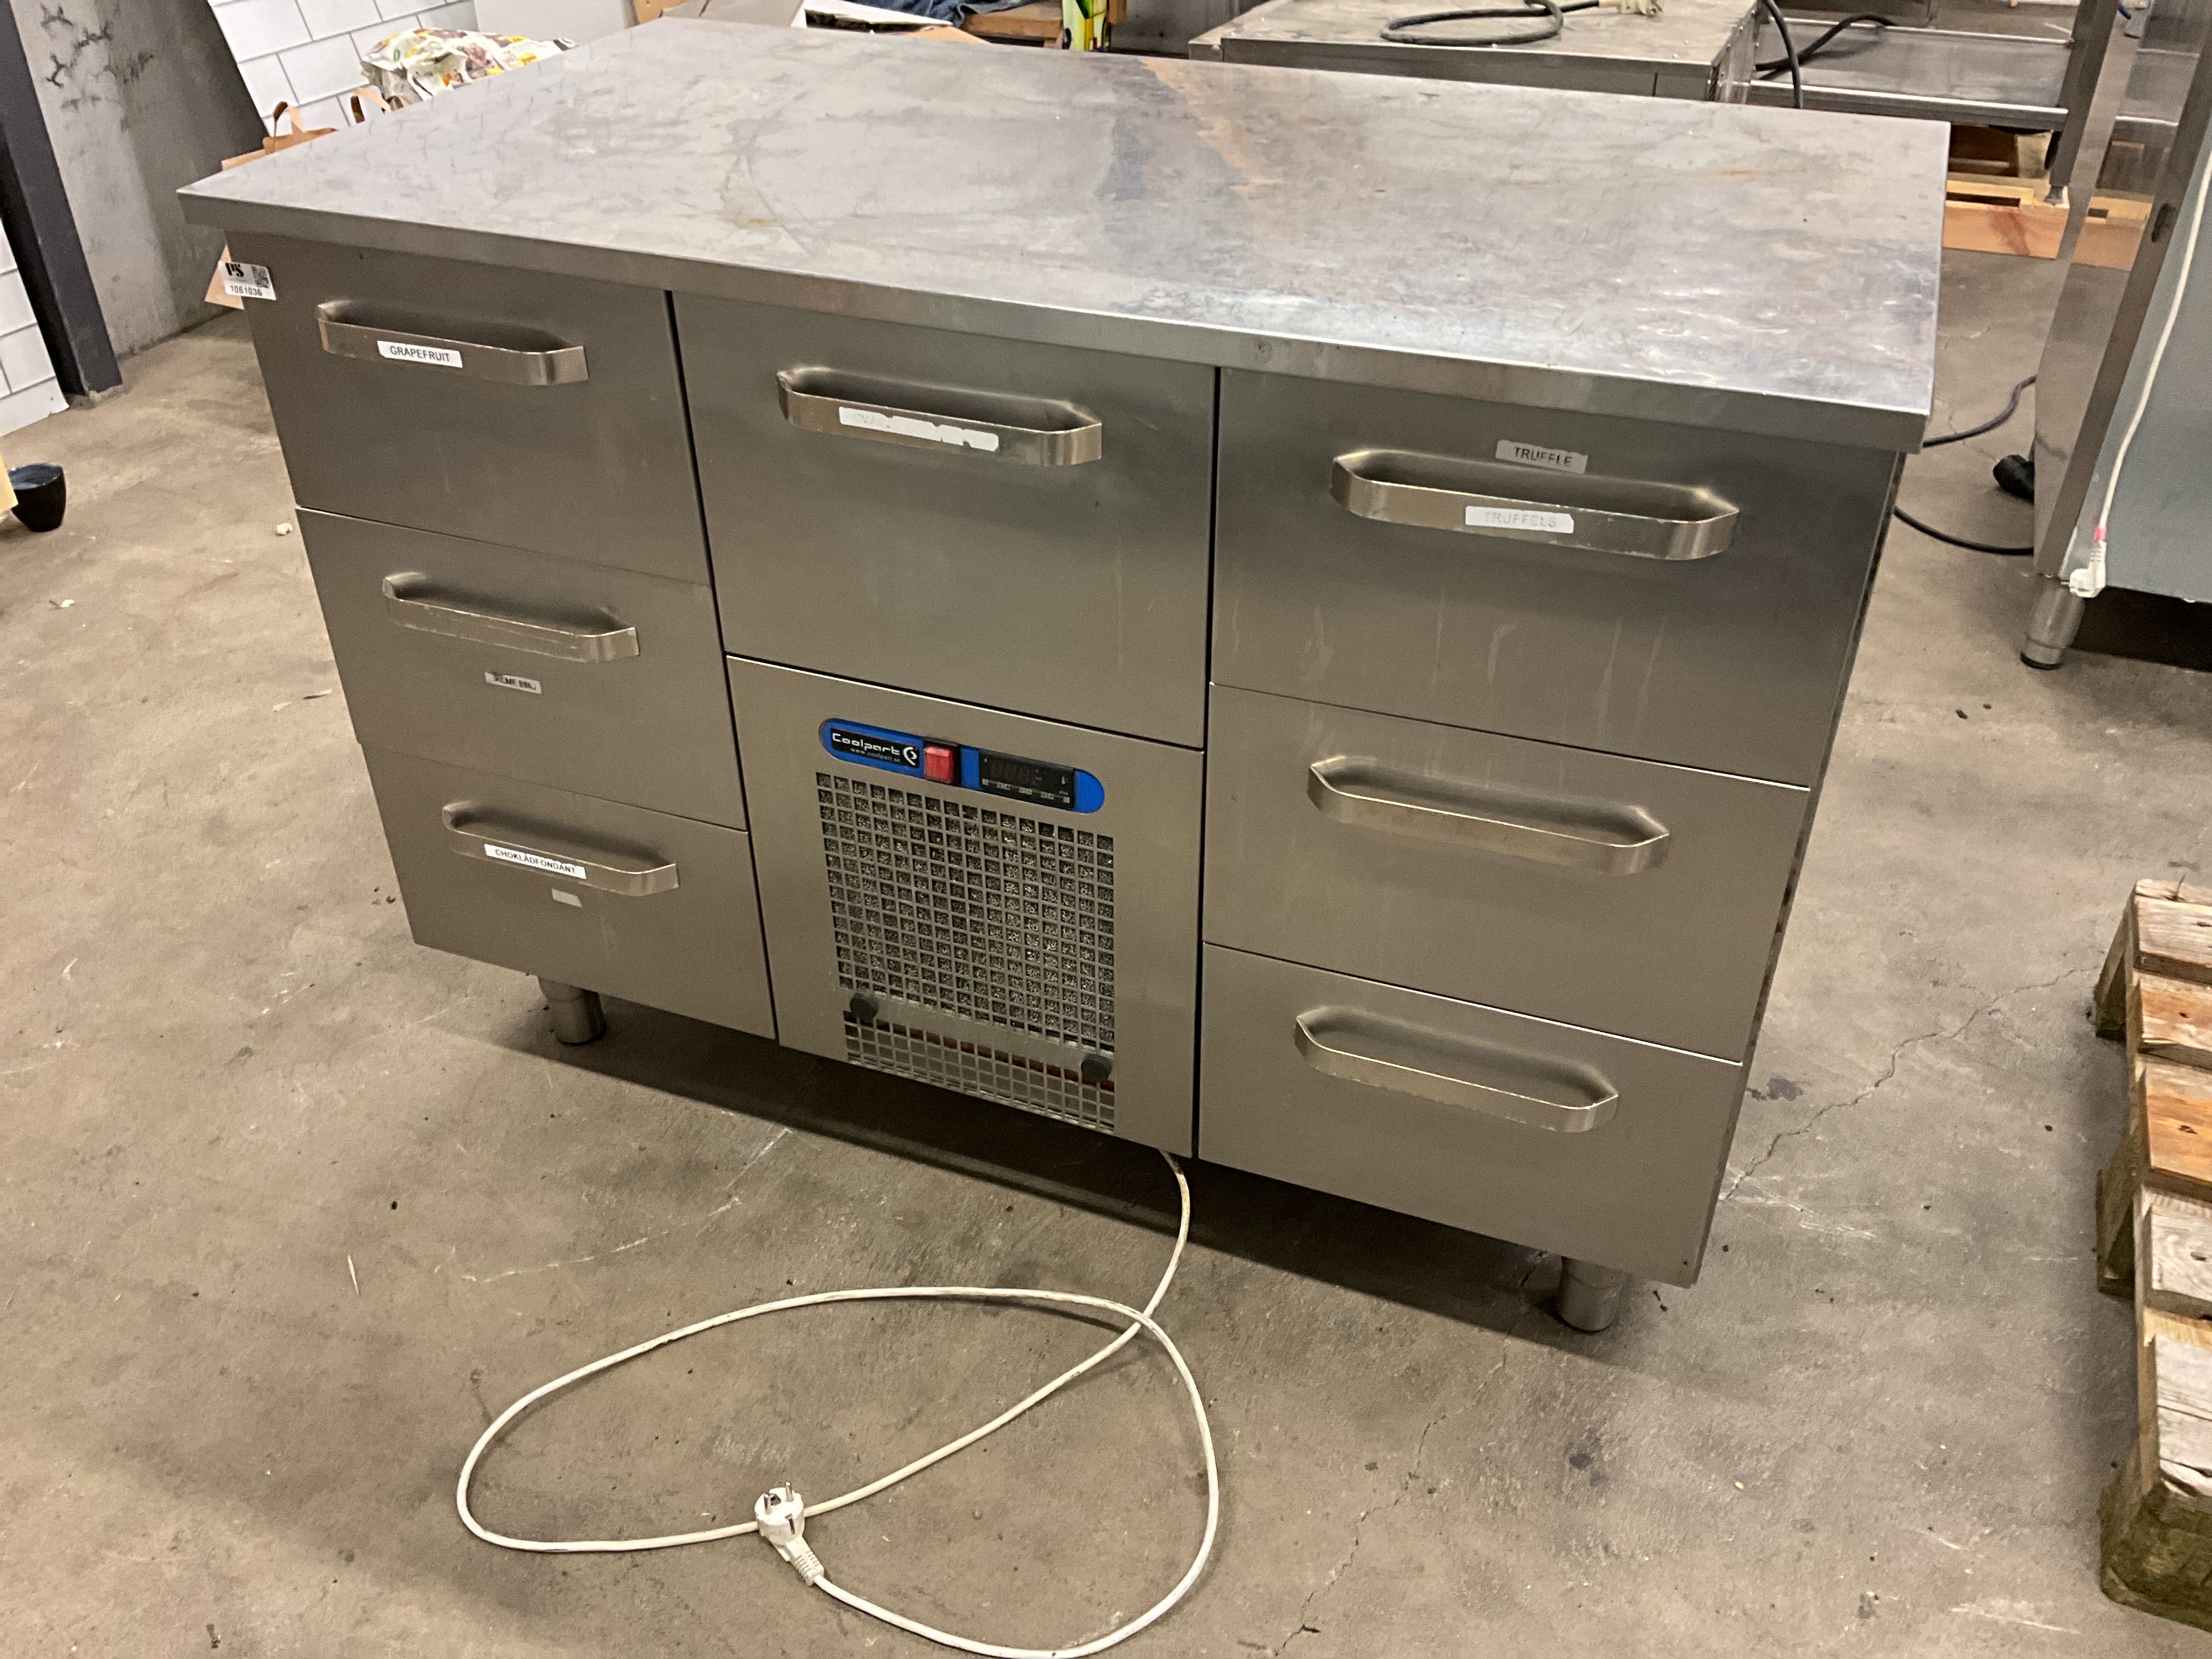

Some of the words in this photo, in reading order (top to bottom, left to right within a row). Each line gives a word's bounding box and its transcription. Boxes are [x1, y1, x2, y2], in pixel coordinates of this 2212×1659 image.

[390, 346, 450, 362] GRAPEFRUIT
[1514, 447, 1573, 467] TRUFFLE
[832, 732, 900, 756] Coolpart
